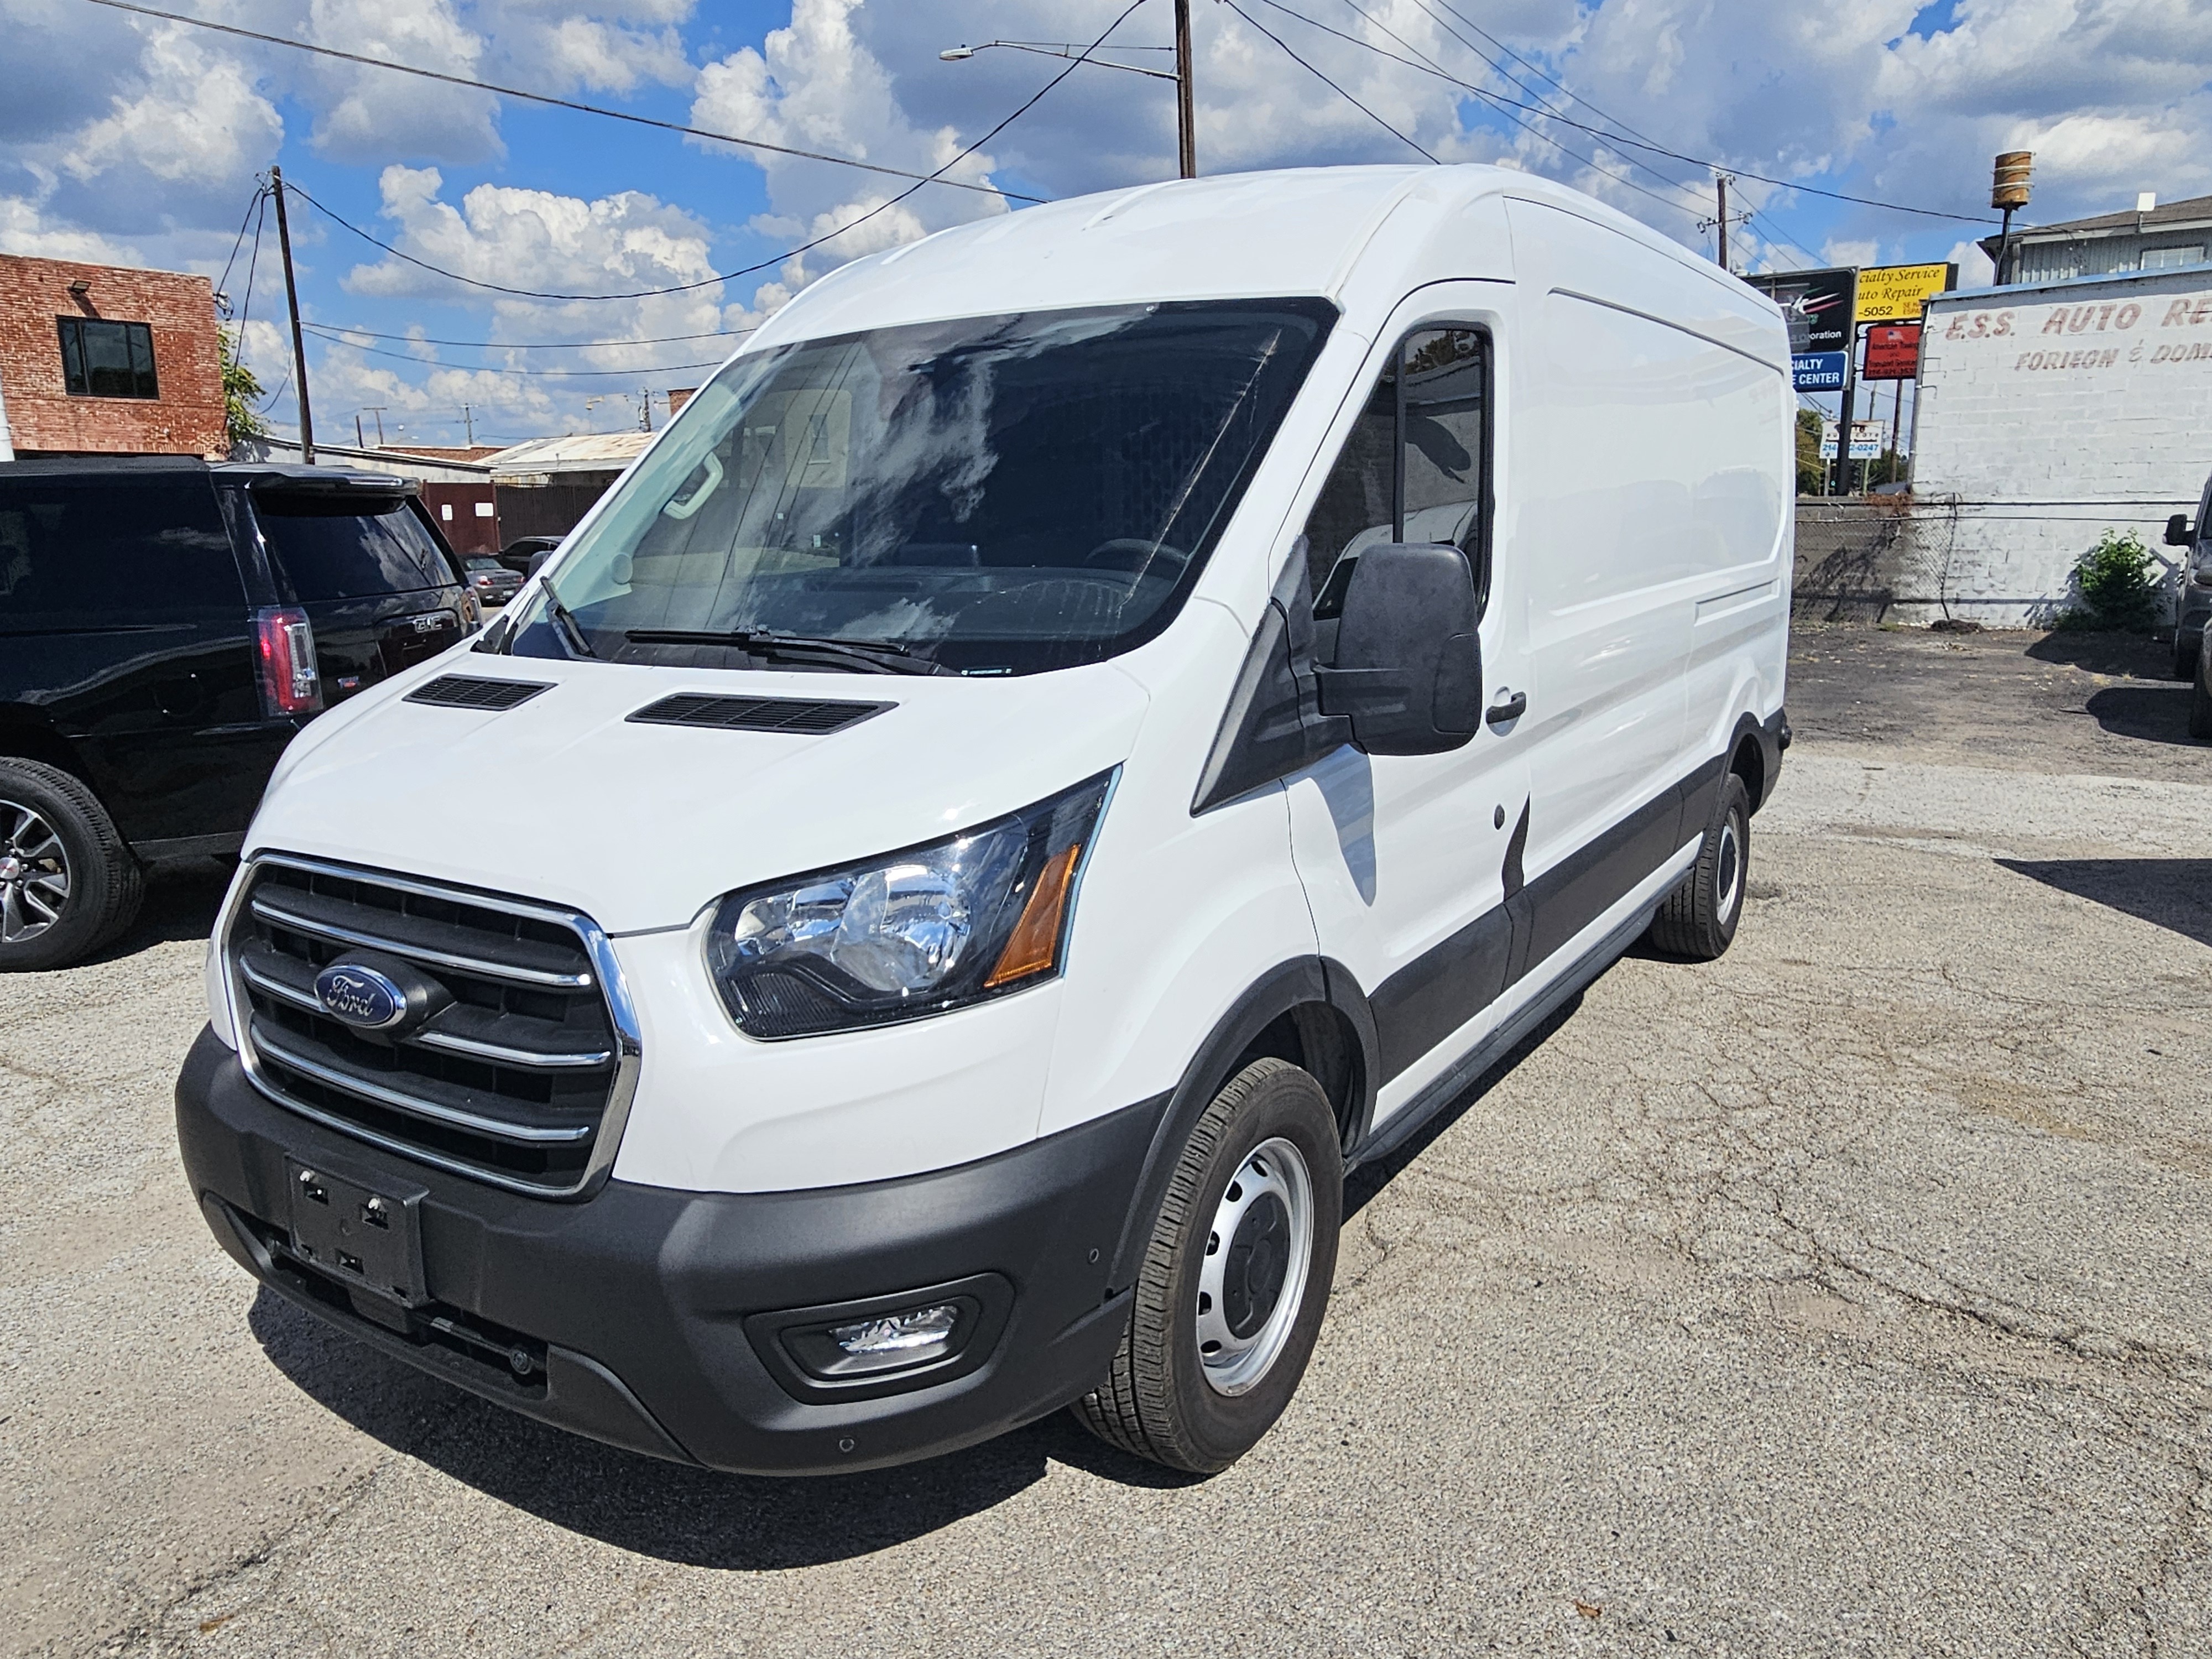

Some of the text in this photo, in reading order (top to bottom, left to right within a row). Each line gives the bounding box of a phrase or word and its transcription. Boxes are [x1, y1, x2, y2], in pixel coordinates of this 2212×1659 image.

[1859, 267, 1940, 285] cialty Service
[1858, 284, 1923, 301] uto Repair
[1945, 298, 2212, 341] E.S.S. AUTO RE
[2015, 348, 2120, 371] FORIEGN
[1799, 372, 1840, 385] CENTER
[327, 974, 376, 1016] Ford
